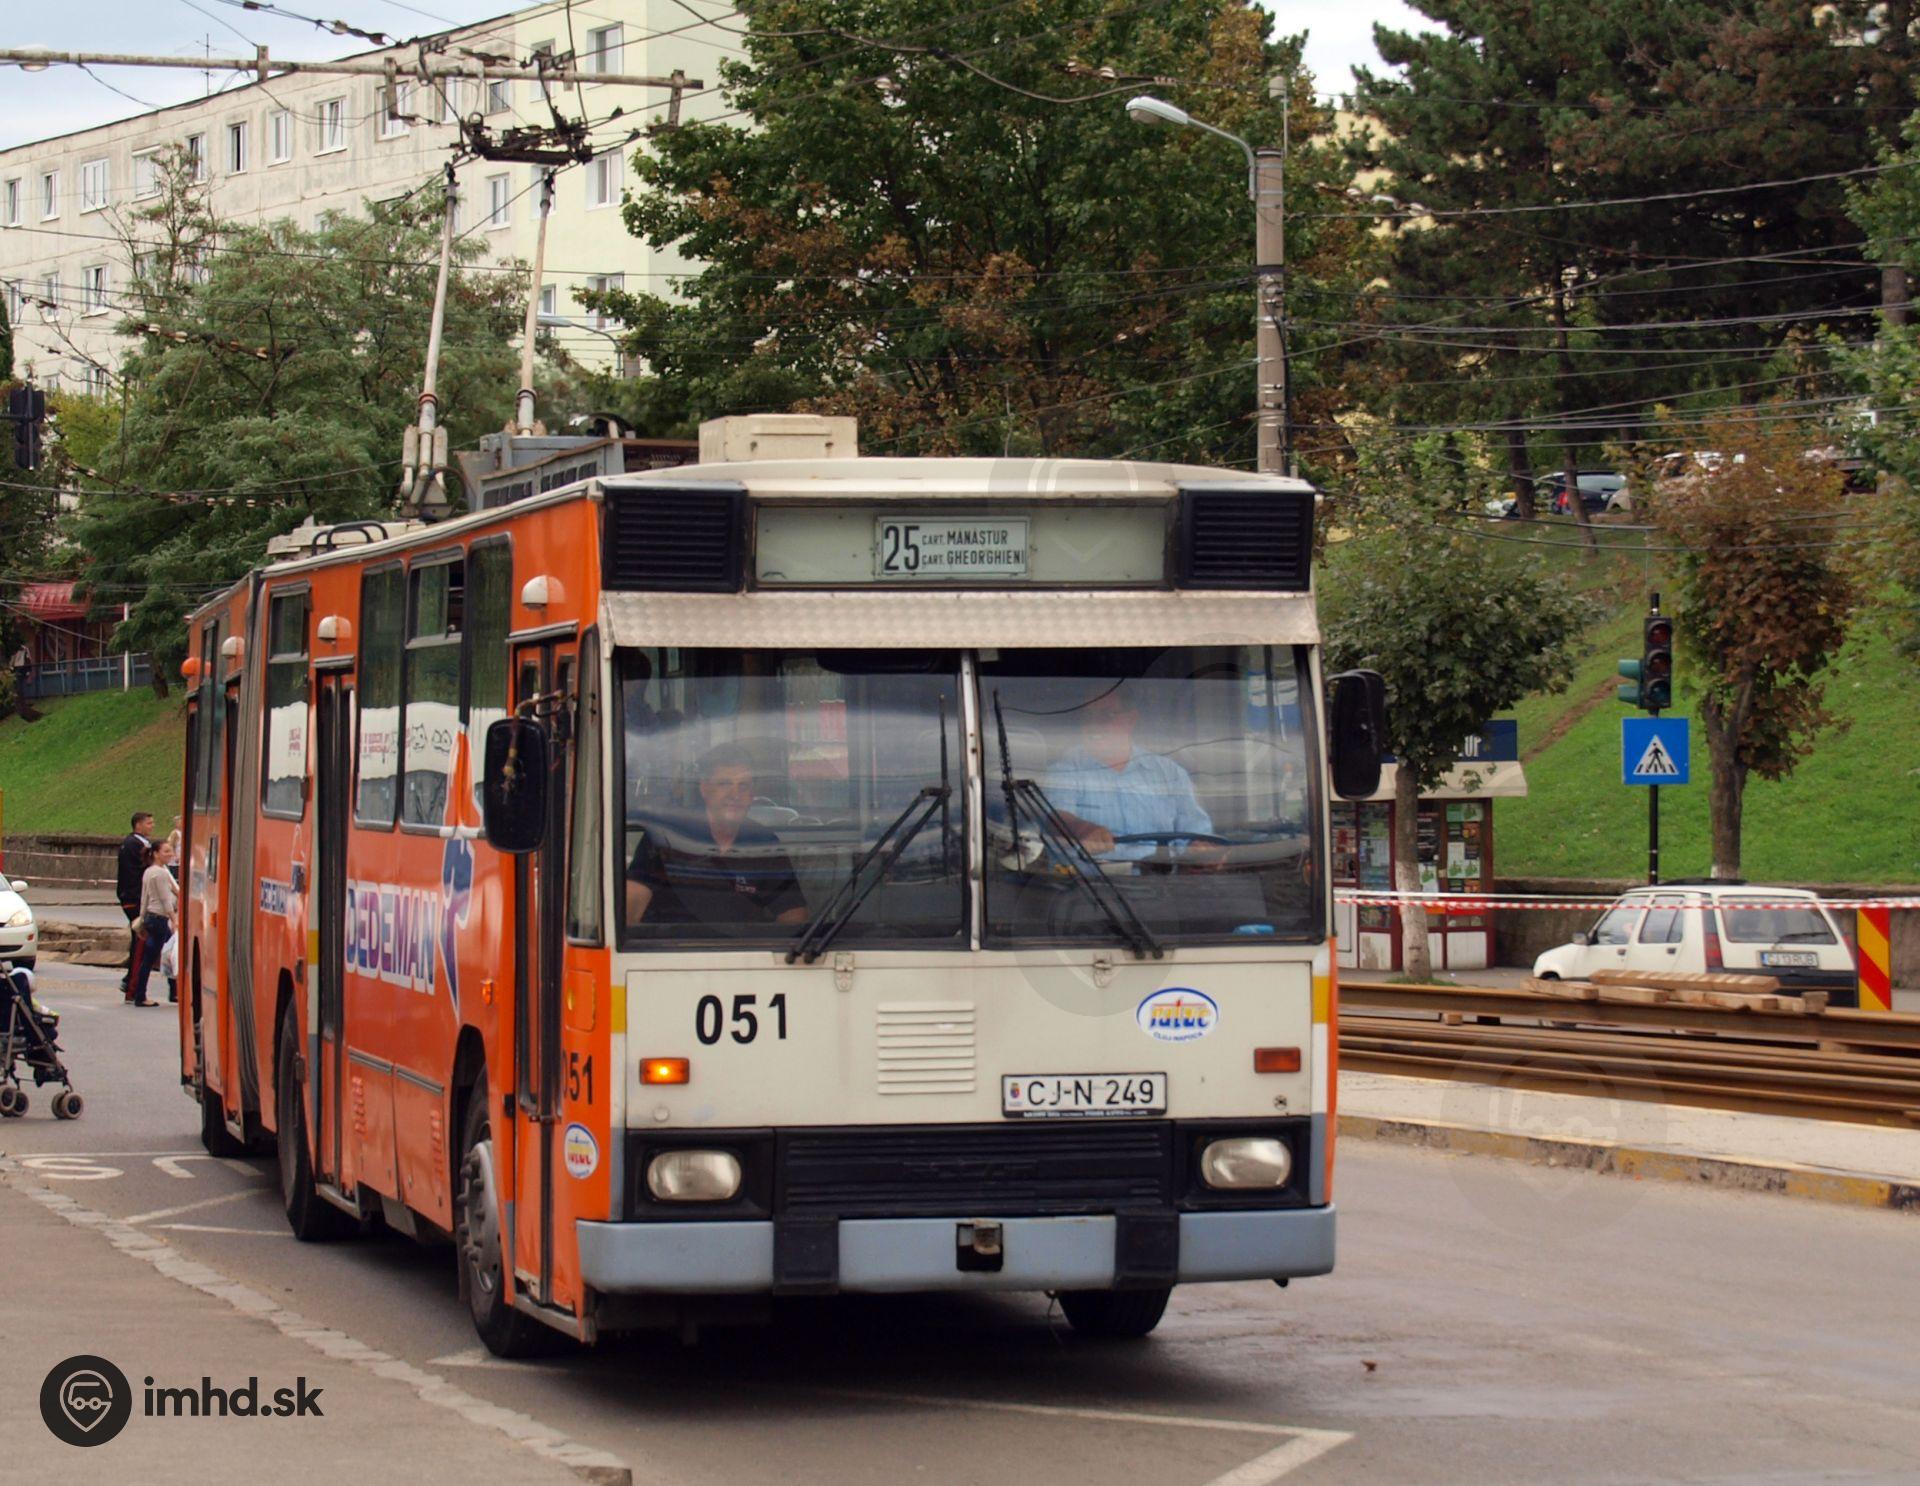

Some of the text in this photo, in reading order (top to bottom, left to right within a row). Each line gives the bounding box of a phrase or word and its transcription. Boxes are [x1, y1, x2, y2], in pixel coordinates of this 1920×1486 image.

[884, 525, 920, 571] 25
[946, 550, 1025, 565] GHEORGHIENI
[344, 881, 437, 992] DEDEMAN
[696, 993, 786, 1045] 051
[1028, 1079, 1154, 1106] CJ-N 249
